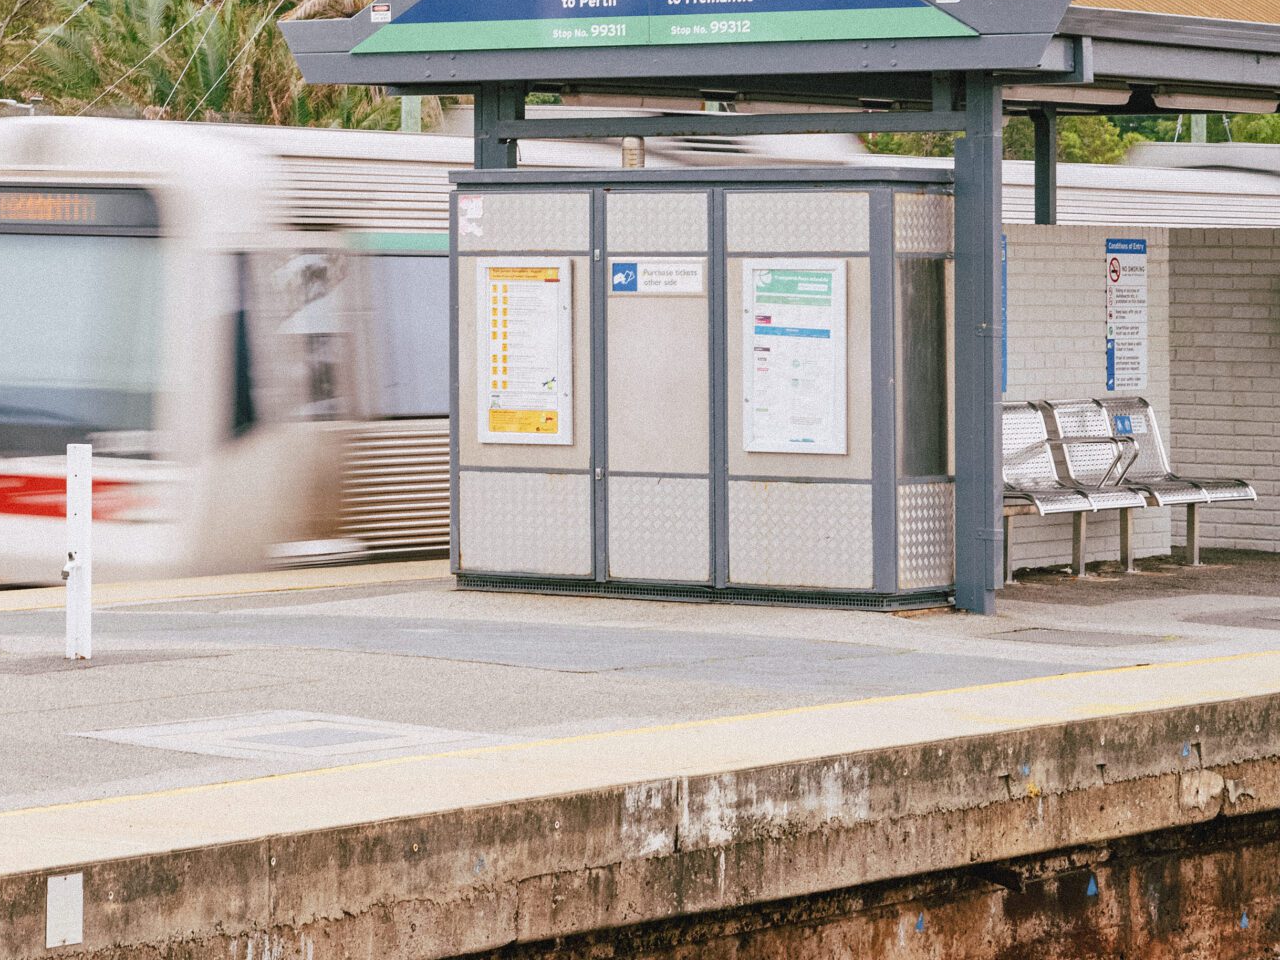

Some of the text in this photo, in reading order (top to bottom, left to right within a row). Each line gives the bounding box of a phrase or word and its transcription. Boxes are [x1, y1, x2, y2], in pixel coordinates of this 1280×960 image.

[553, 24, 626, 40] Stop No. 99311
[671, 20, 750, 36] Stop No. 99312
